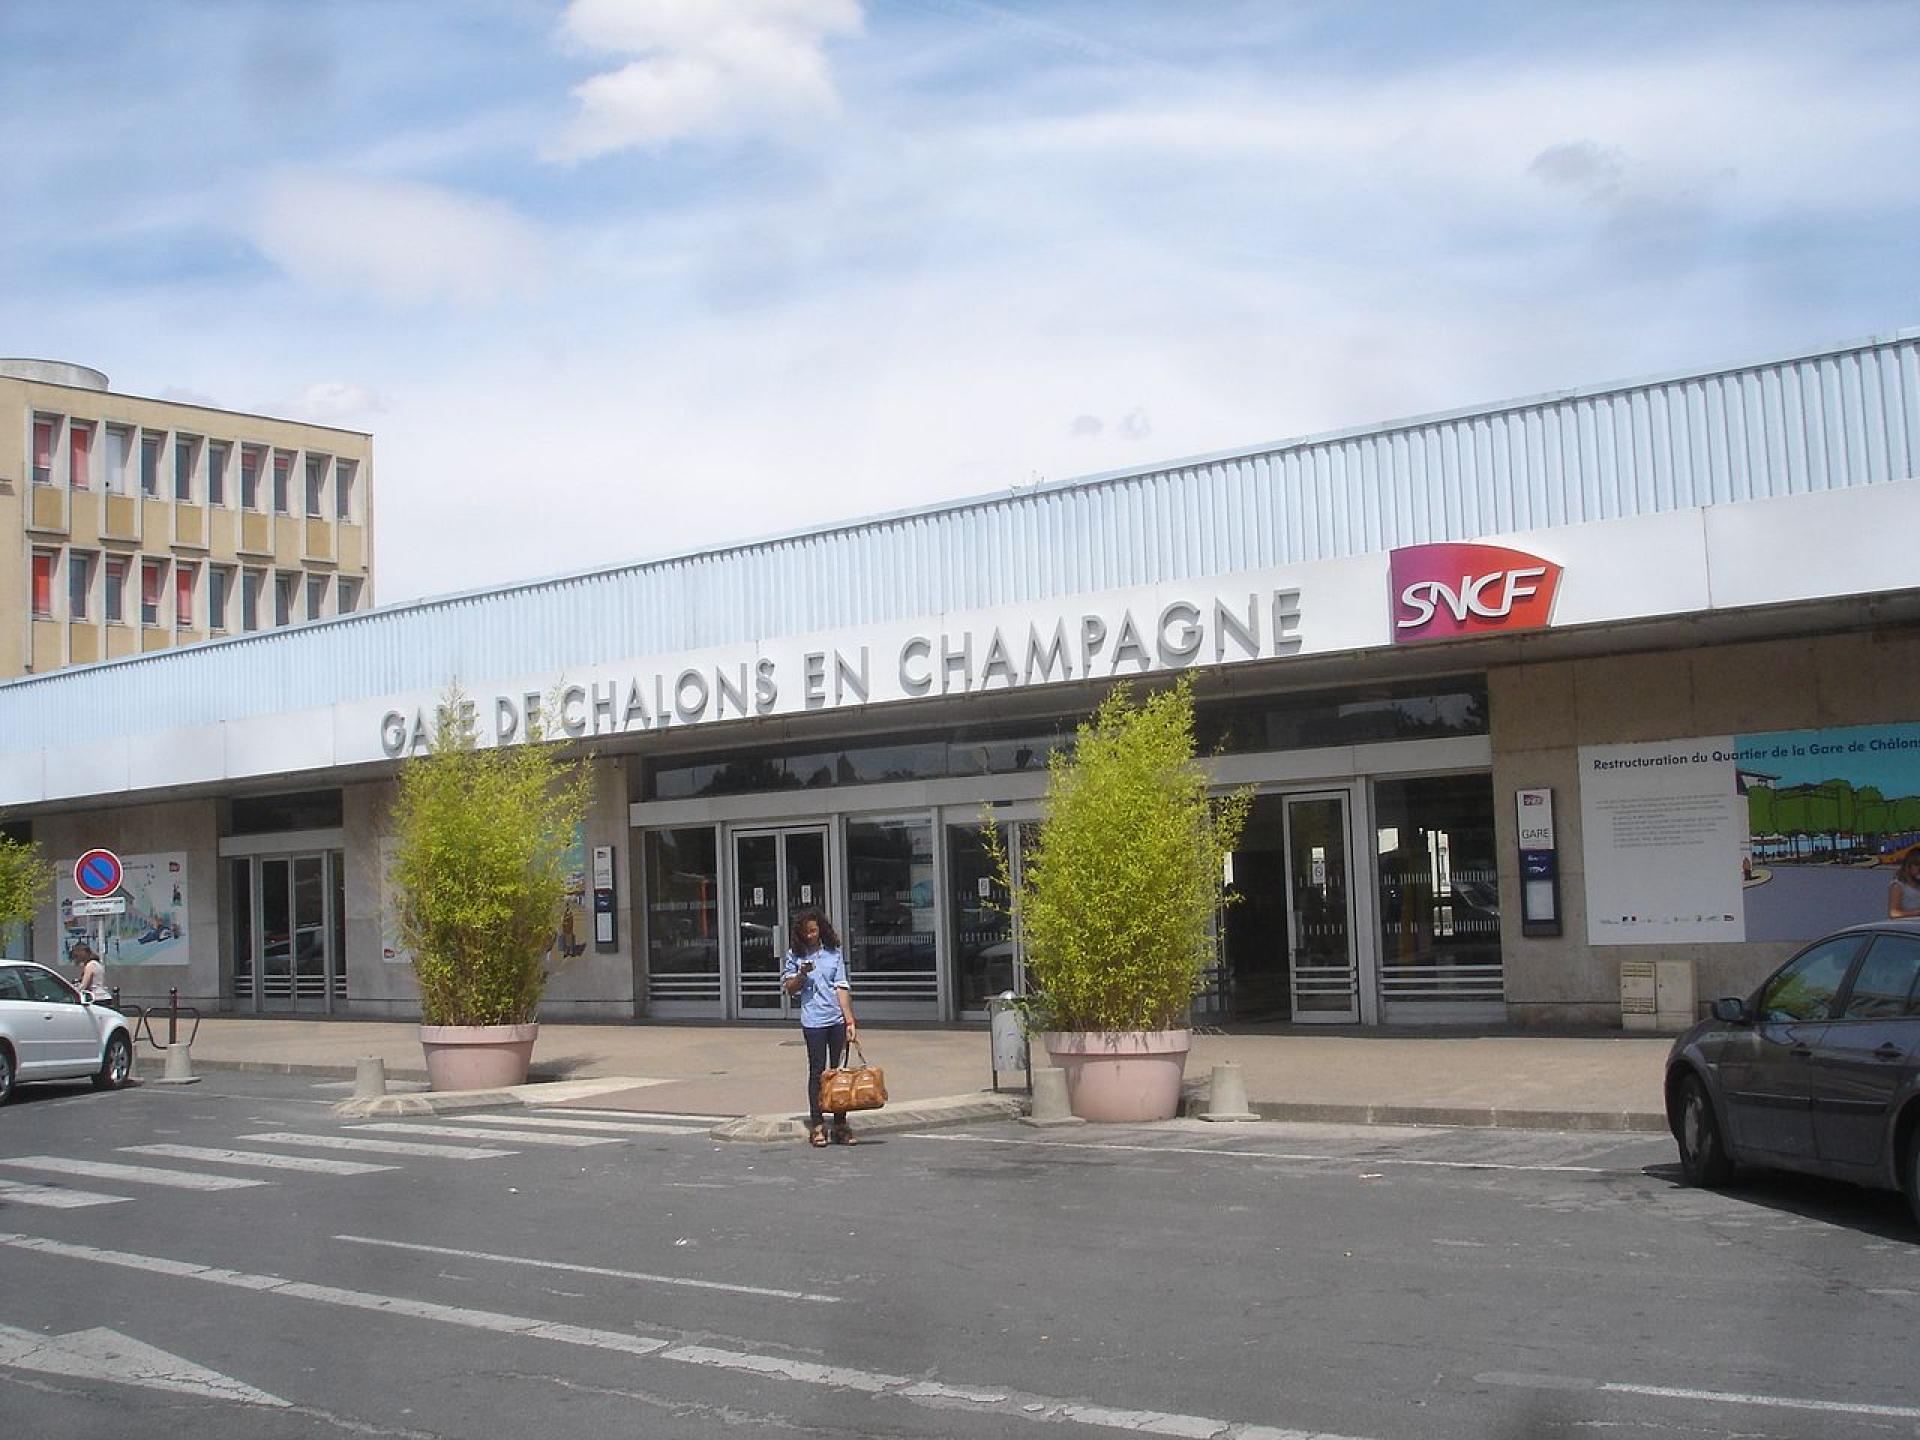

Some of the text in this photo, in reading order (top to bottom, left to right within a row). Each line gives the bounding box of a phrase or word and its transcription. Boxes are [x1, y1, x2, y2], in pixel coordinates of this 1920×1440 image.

[1397, 566, 1547, 629] SNCF
[496, 690, 542, 745] DE
[561, 657, 778, 737] CHALONS
[804, 646, 870, 711] EN
[899, 587, 1302, 694] CHAMPAGNE
[1593, 738, 1920, 770] Restructuration du Quartier de la Gare de Châlon
[1522, 828, 1550, 839] GARE
